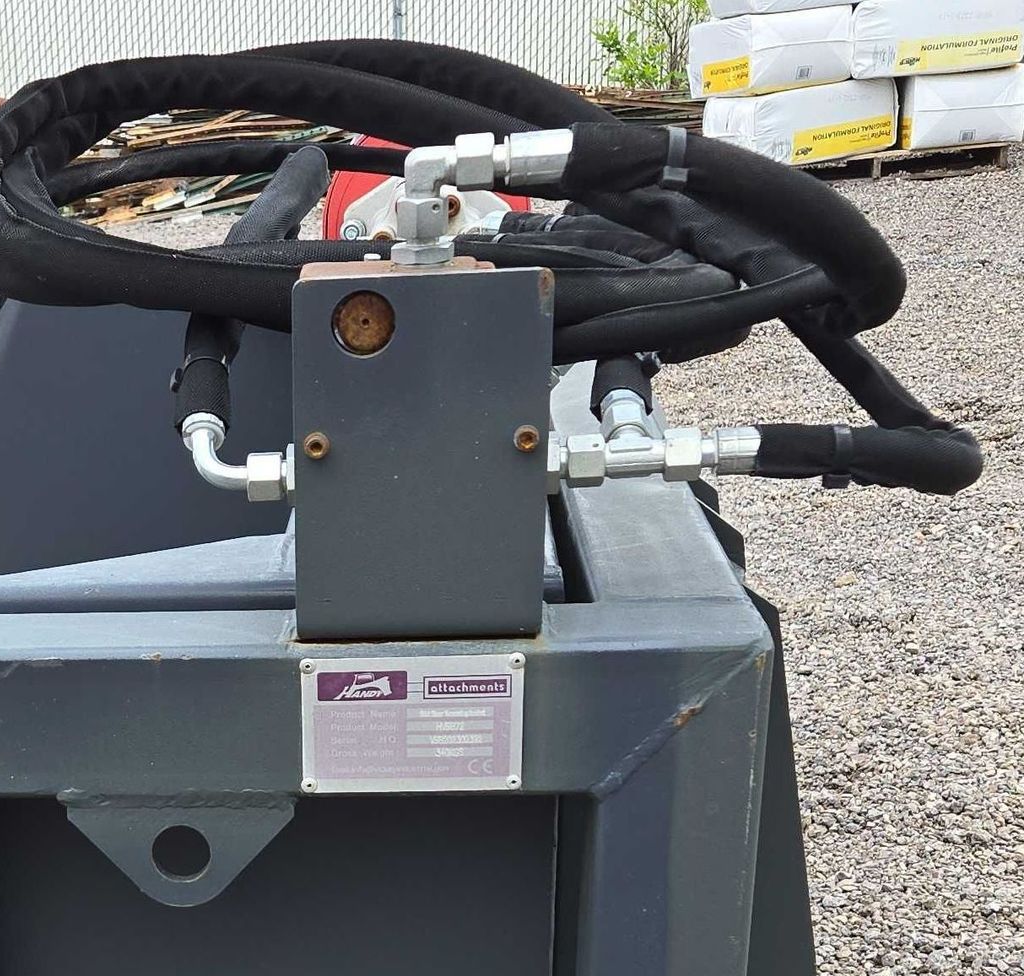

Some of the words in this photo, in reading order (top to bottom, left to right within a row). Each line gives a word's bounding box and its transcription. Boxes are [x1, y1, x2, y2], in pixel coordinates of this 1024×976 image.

[920, 39, 978, 52] FORMULATION
[979, 34, 1019, 46] ORIGINAL
[861, 120, 891, 132] ORIGINAL
[812, 127, 860, 142] FORMULATION
[333, 685, 385, 700] HANDY
[430, 681, 506, 693] attachments
